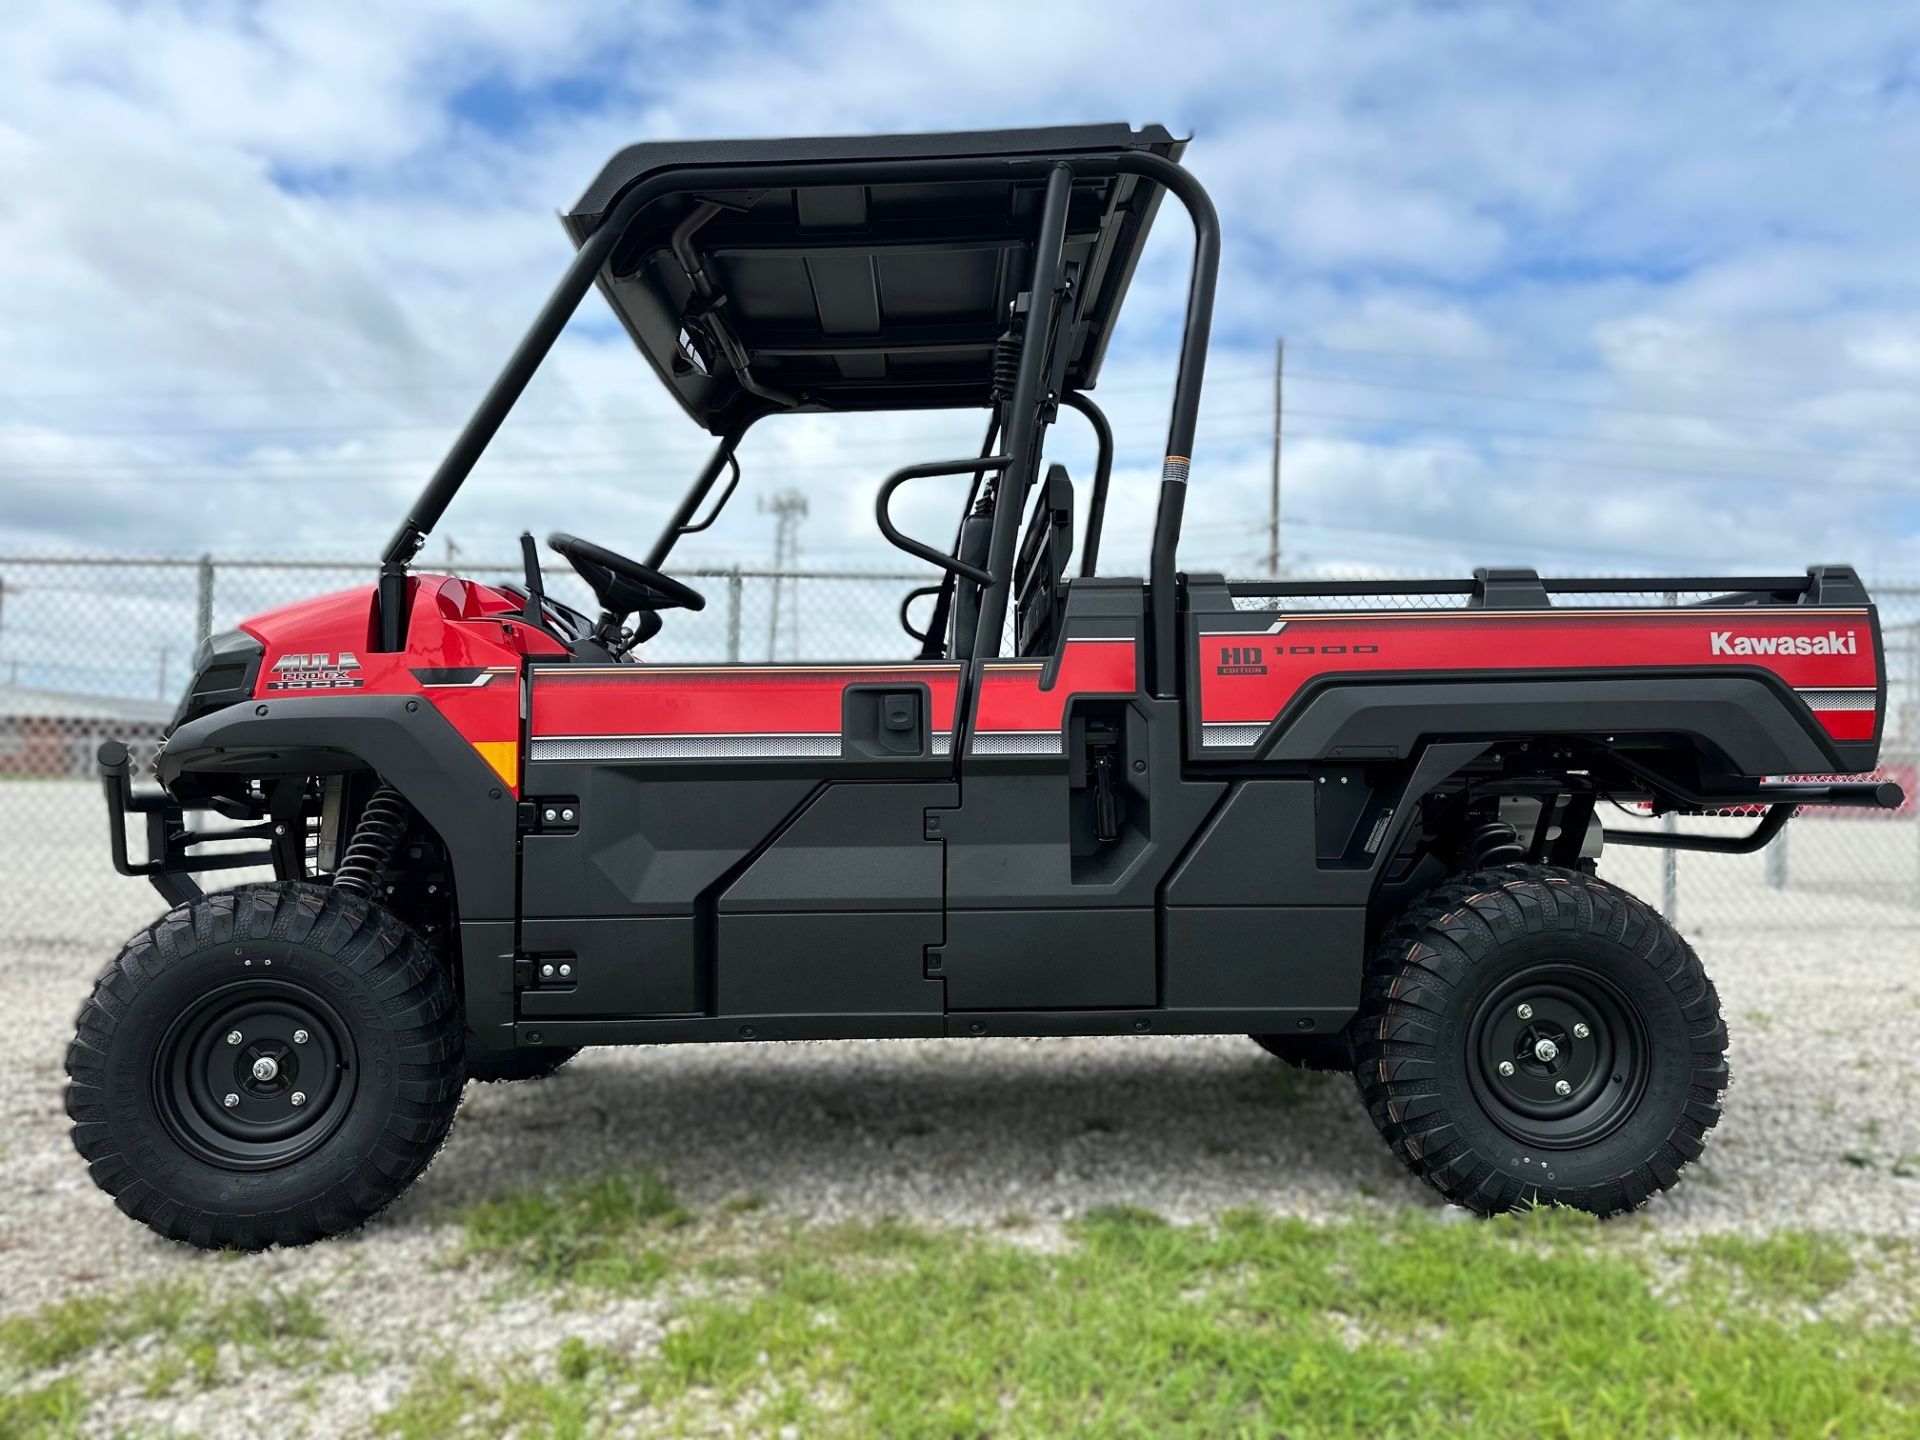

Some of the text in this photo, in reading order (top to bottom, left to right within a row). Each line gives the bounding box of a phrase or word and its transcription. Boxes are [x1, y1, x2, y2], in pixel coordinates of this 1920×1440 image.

[1710, 631, 1857, 655] Kawasaki
[271, 652, 362, 672] MULE
[1221, 646, 1378, 665] HD 1000
[277, 681, 356, 689] 1000
[282, 672, 320, 680] PRO
